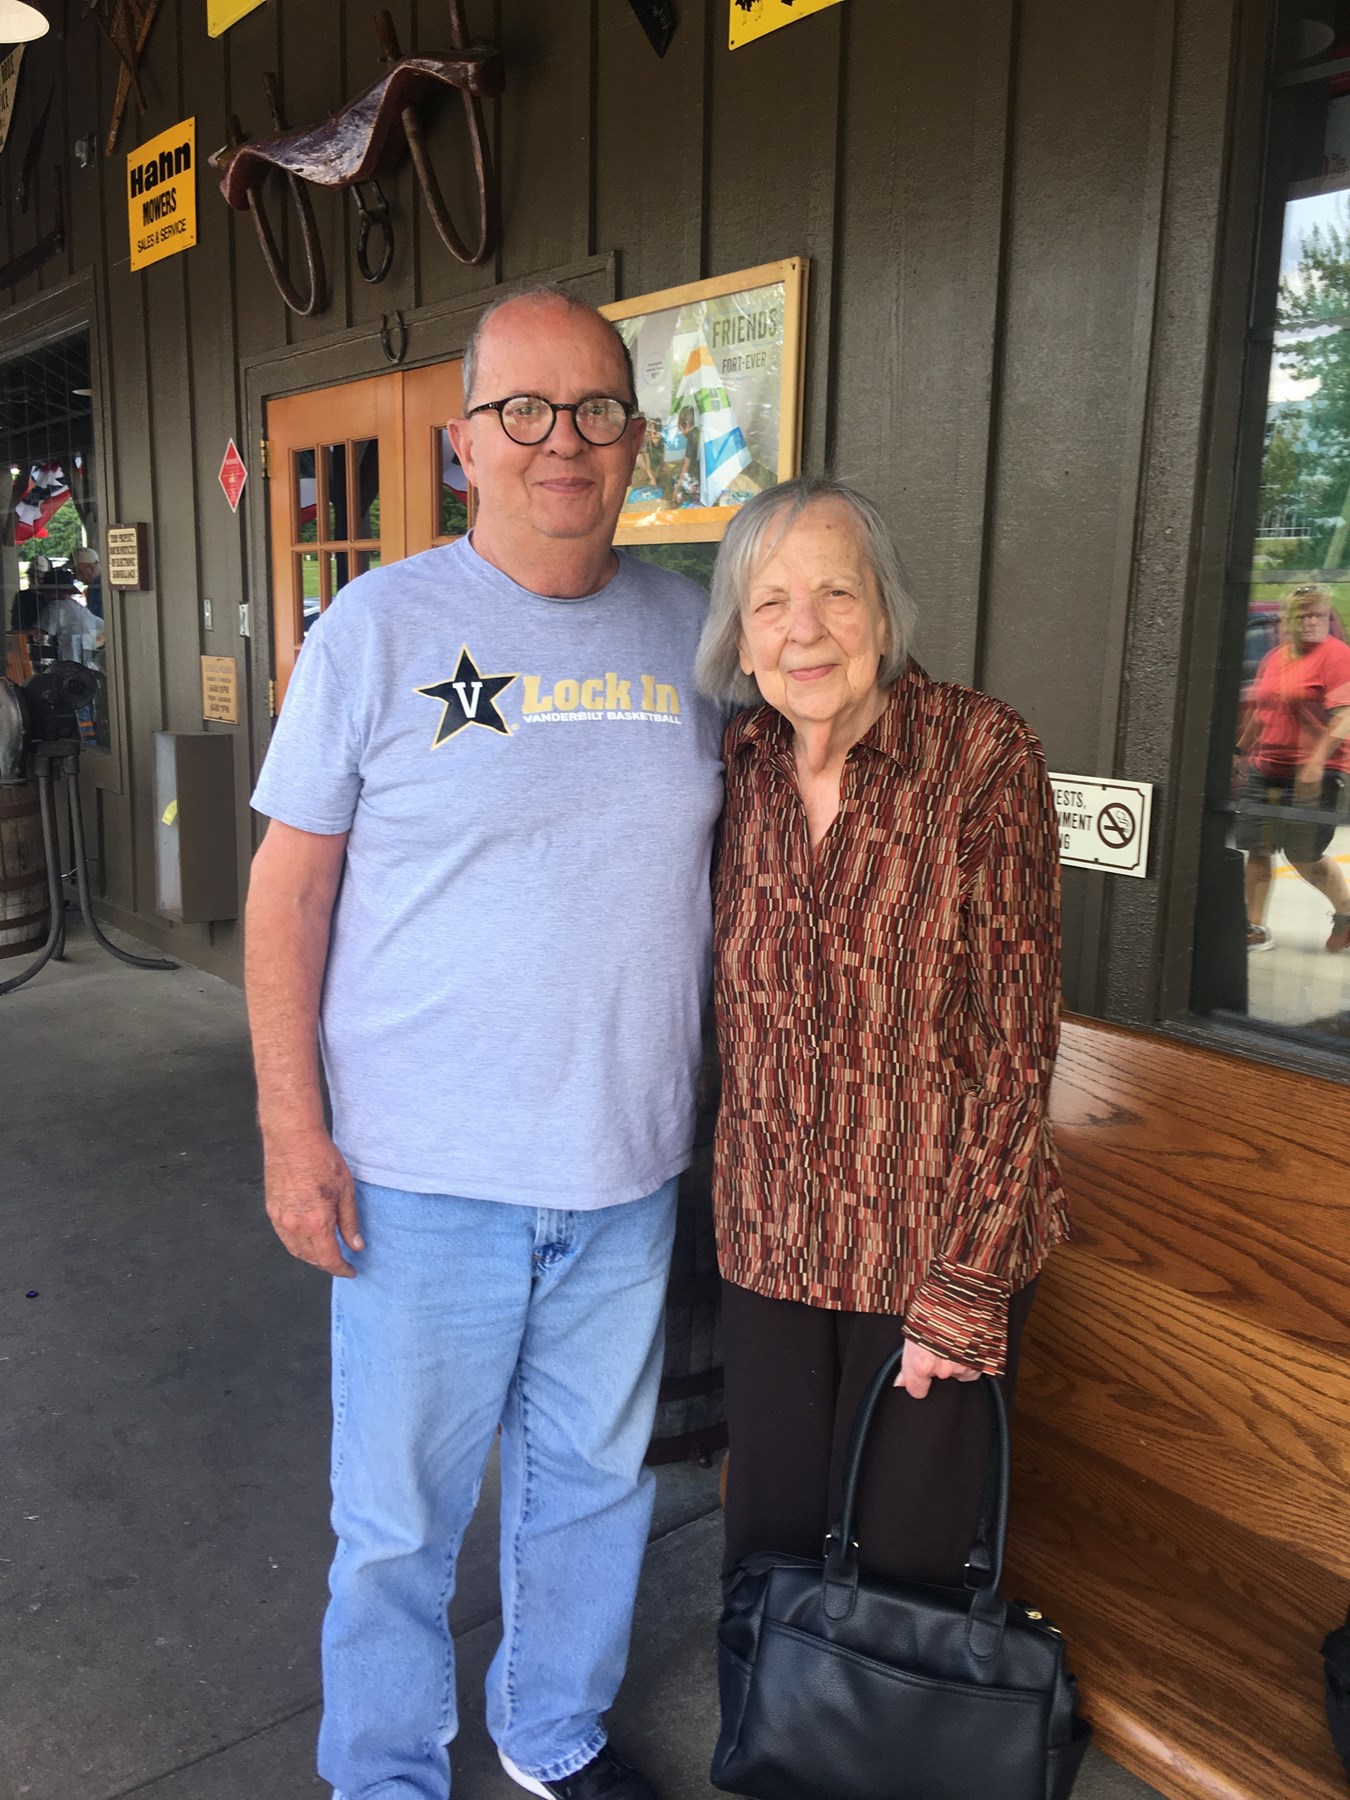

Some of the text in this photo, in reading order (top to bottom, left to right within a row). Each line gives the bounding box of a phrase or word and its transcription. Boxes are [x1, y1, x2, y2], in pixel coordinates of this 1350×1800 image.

[130, 142, 192, 199] Hann
[142, 187, 177, 227] MOWERS
[137, 233, 155, 253] SALES
[160, 218, 187, 242] SERVICE
[712, 308, 777, 348] FRIENDS
[722, 351, 767, 374] FORT-EVER
[452, 681, 483, 719] V
[522, 672, 681, 715] Lock In
[522, 711, 682, 725] VANDERBILT BASKETBALL
